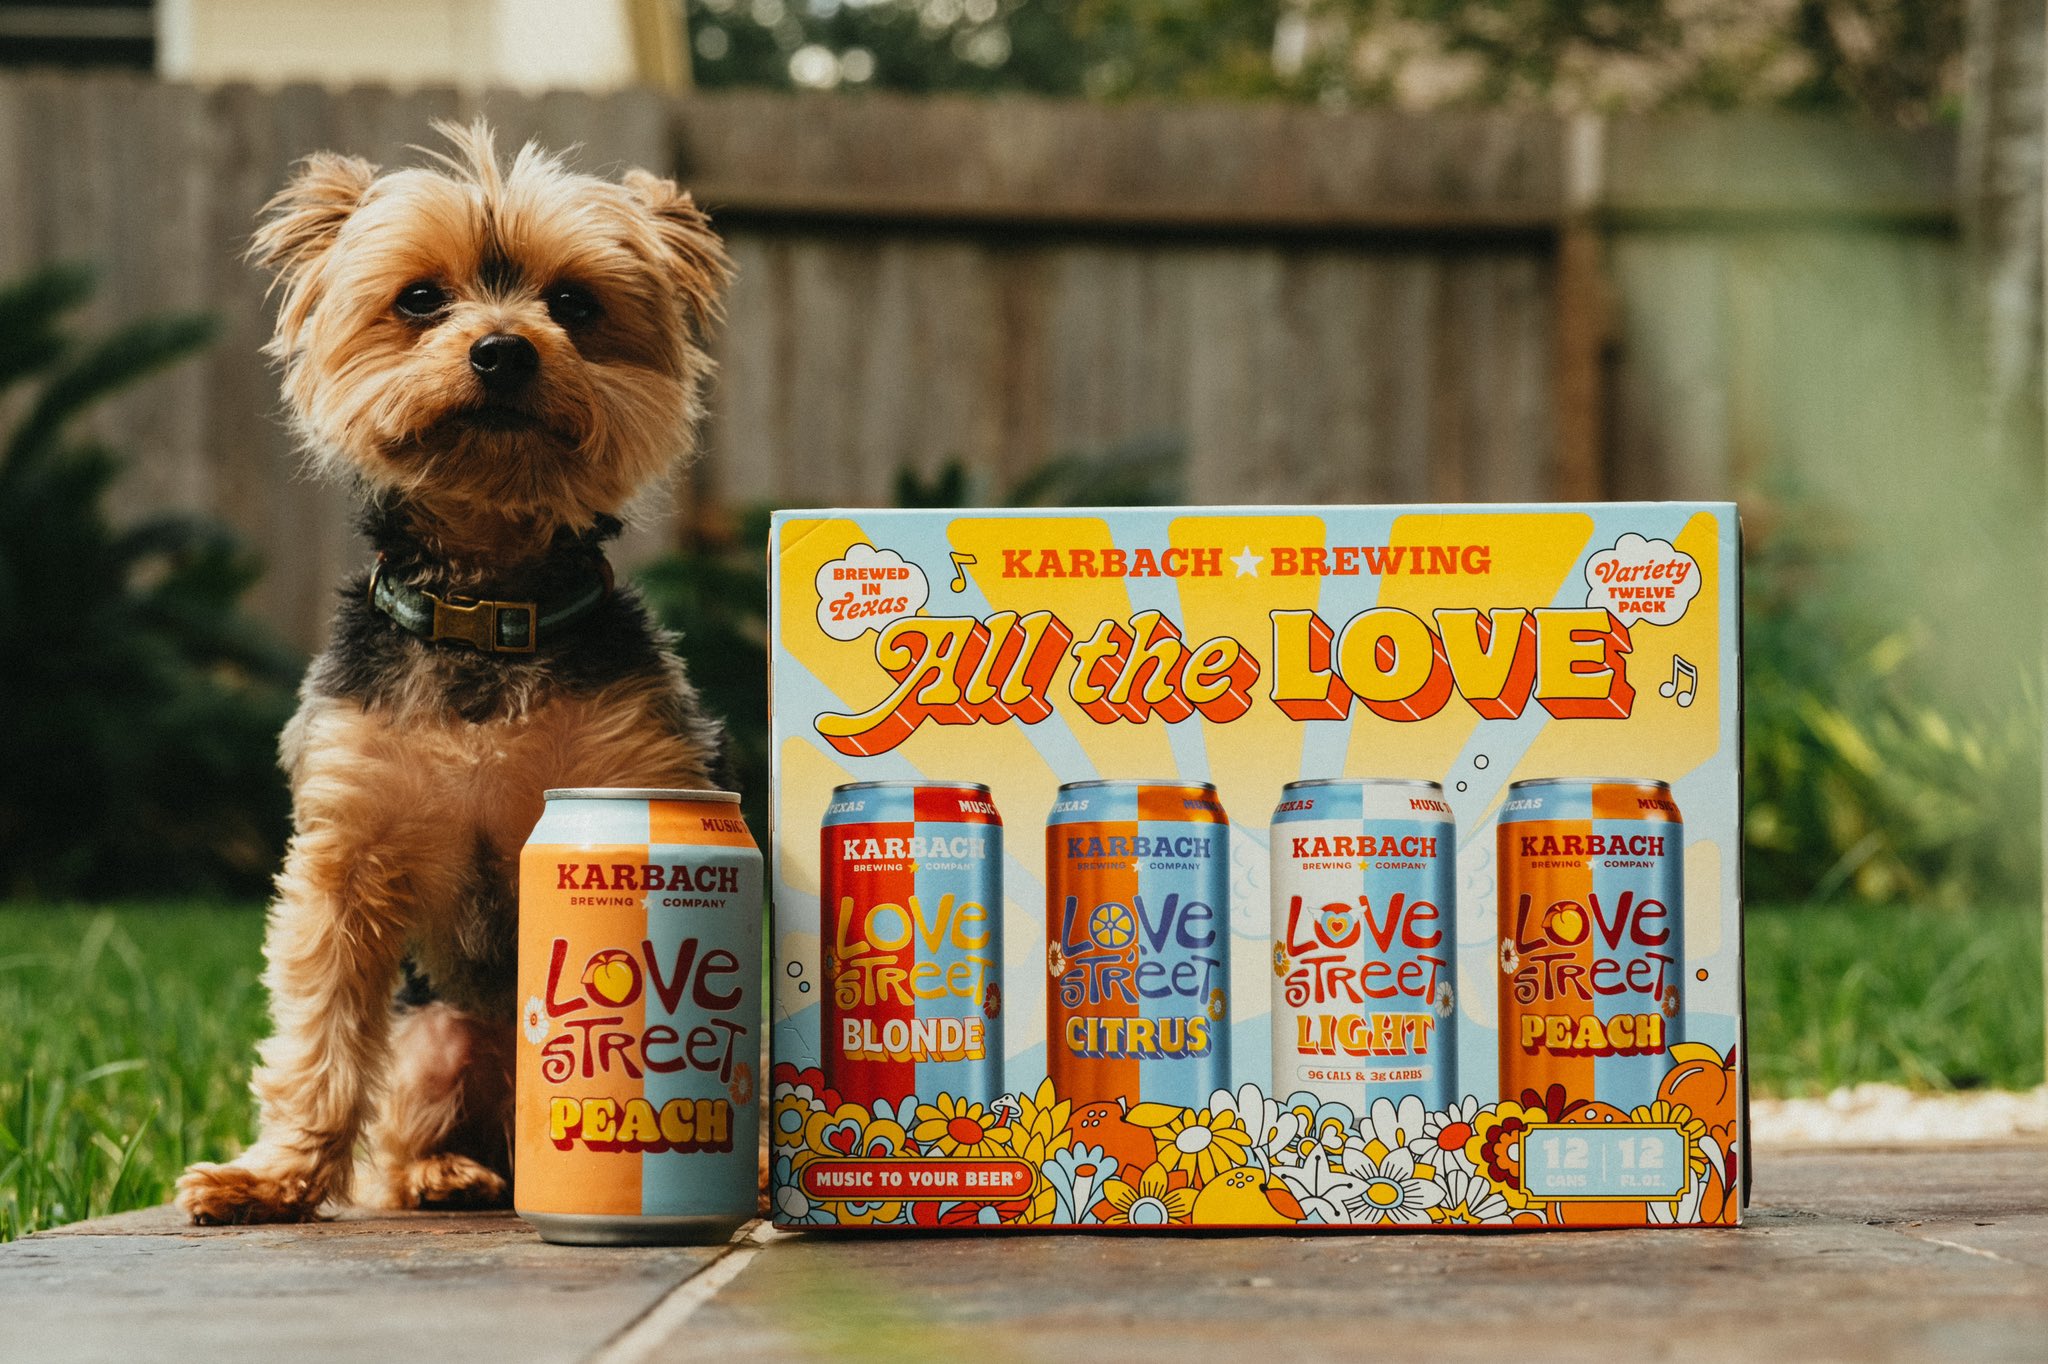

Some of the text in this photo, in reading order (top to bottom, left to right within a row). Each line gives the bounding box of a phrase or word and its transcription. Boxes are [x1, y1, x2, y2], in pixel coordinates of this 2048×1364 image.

[1002, 545, 1491, 578] KARBACH BREWING
[833, 567, 909, 581] BREWED
[1594, 558, 1692, 585] Variety
[861, 583, 881, 595] IN
[1608, 587, 1675, 599] TWELVE
[830, 596, 908, 621] Texas
[1619, 601, 1666, 613] PACK
[814, 607, 1636, 756] All the LOVE
[958, 800, 995, 815] MUSIC
[1409, 799, 1444, 812] MUSIC
[1637, 799, 1674, 811] MUSIC
[701, 818, 742, 833] MUSIC
[844, 837, 985, 860] KARBACH
[1068, 836, 1210, 859] KARBACH
[1292, 836, 1437, 858] KARBACH
[1521, 835, 1664, 857] KARBACH
[854, 863, 975, 872] BREWING COMPANY
[1078, 862, 1200, 870] BREWING COMPANY
[1302, 861, 1428, 870] BREWING COMPANY
[1531, 860, 1654, 868] BREWING COMPANY
[557, 863, 739, 893] KARBACH
[570, 896, 726, 908] BREWING COMPANY
[843, 1017, 985, 1063] BLONDE
[1066, 1016, 1212, 1060] CITRUS
[1297, 1013, 1435, 1057] LIGHT
[1521, 1013, 1665, 1058] PEACH
[1308, 1070, 1323, 1080] 96
[1327, 1070, 1351, 1080] CALS
[1355, 1071, 1365, 1081] &
[1389, 1069, 1422, 1080] CARBS
[550, 1096, 734, 1154] PEACH
[1542, 1136, 1589, 1169] 12
[1618, 1136, 1664, 1169] 12
[816, 1171, 873, 1187] MUSIC
[880, 1171, 902, 1186] TO
[909, 1171, 959, 1187] YOUR
[1546, 1174, 1587, 1188] CANS
